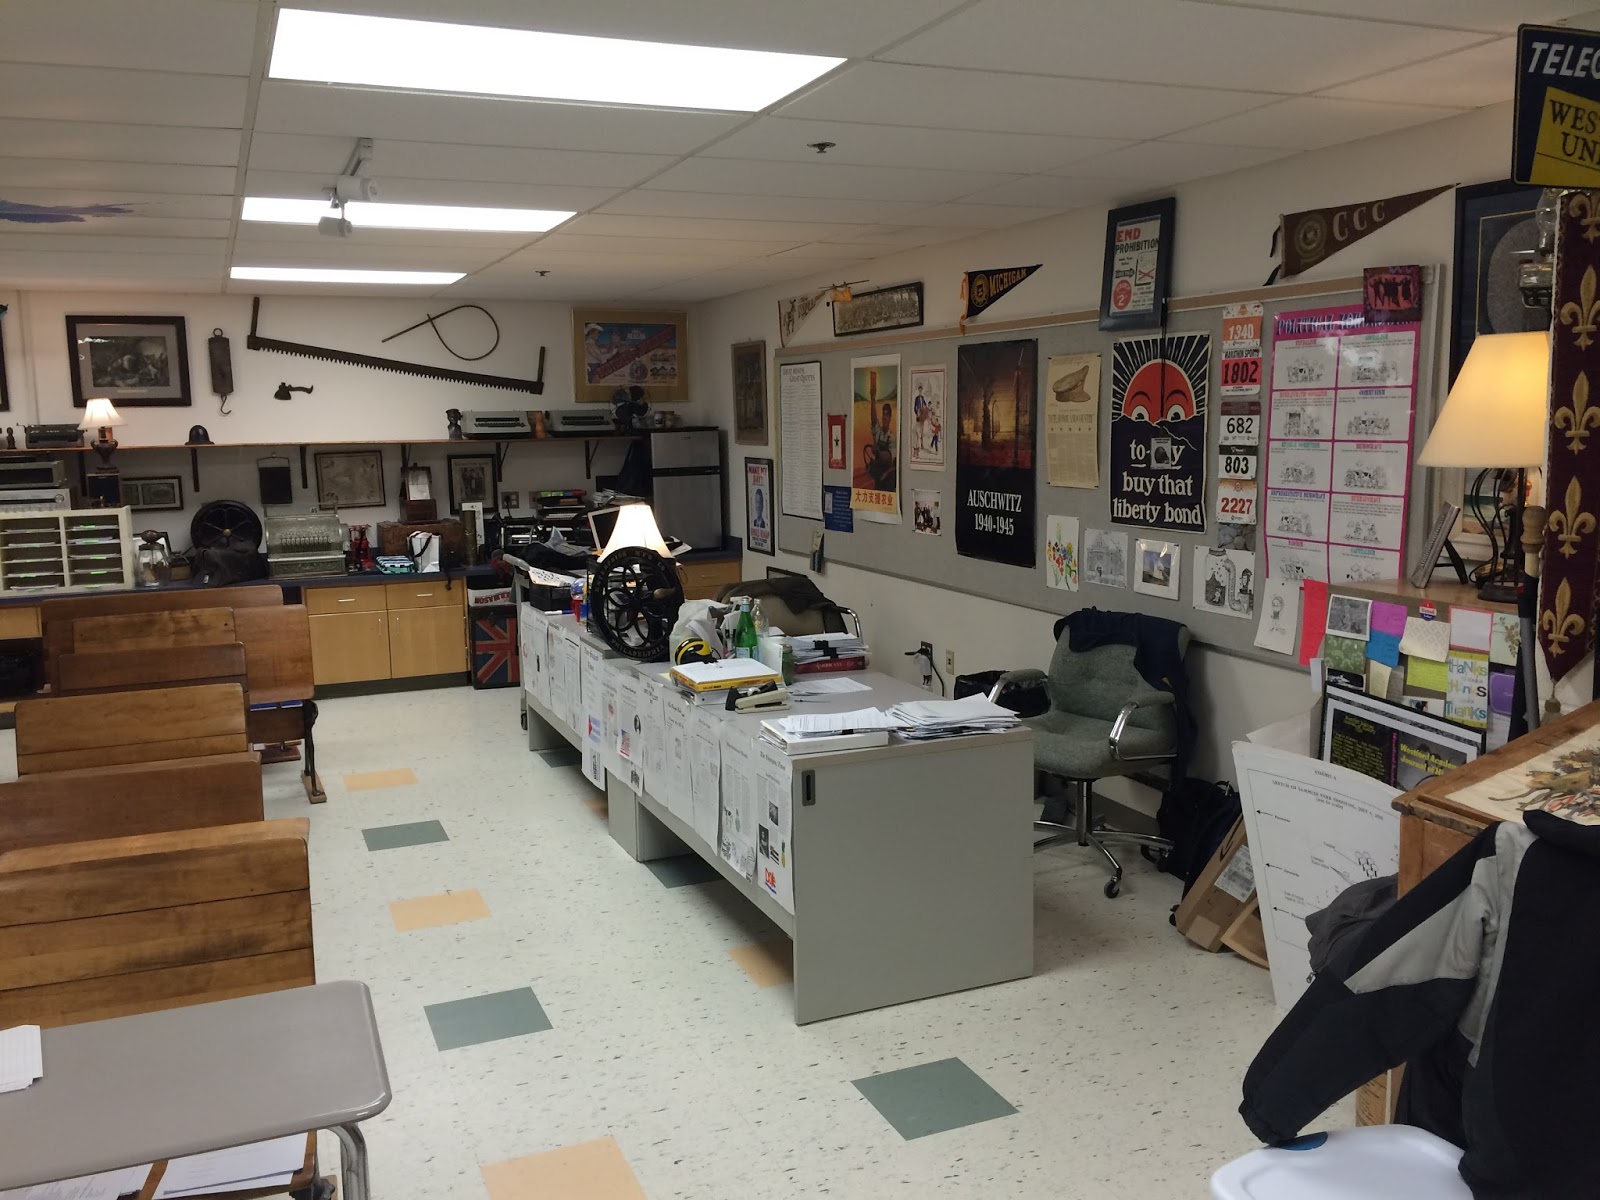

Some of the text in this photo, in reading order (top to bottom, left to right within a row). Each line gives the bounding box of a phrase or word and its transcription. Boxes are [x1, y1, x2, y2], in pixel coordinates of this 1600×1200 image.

[1550, 99, 1600, 133] WES
[1116, 227, 1141, 242] END
[1115, 238, 1159, 255] PROHIBITION
[990, 268, 1027, 297] MICHIGAN
[1118, 295, 1125, 306] 2
[1229, 324, 1254, 340] 1340
[1225, 348, 1260, 359] MARATHON SPORTS
[1224, 361, 1259, 384] 1802
[1226, 417, 1254, 434] 682
[1130, 438, 1186, 465] to-y
[1224, 456, 1250, 474] 803
[1122, 471, 1194, 499] buy that
[966, 489, 1022, 513] AUSCHWITZ
[1221, 497, 1253, 515] 2227
[1112, 497, 1202, 525] liberty bond
[974, 513, 1014, 536] 1940-1945
[611, 639, 665, 657] PHILADELPHIA
[1400, 743, 1459, 771] Westford Academ
[1400, 755, 1427, 772] Journal
[1427, 764, 1436, 774] of
